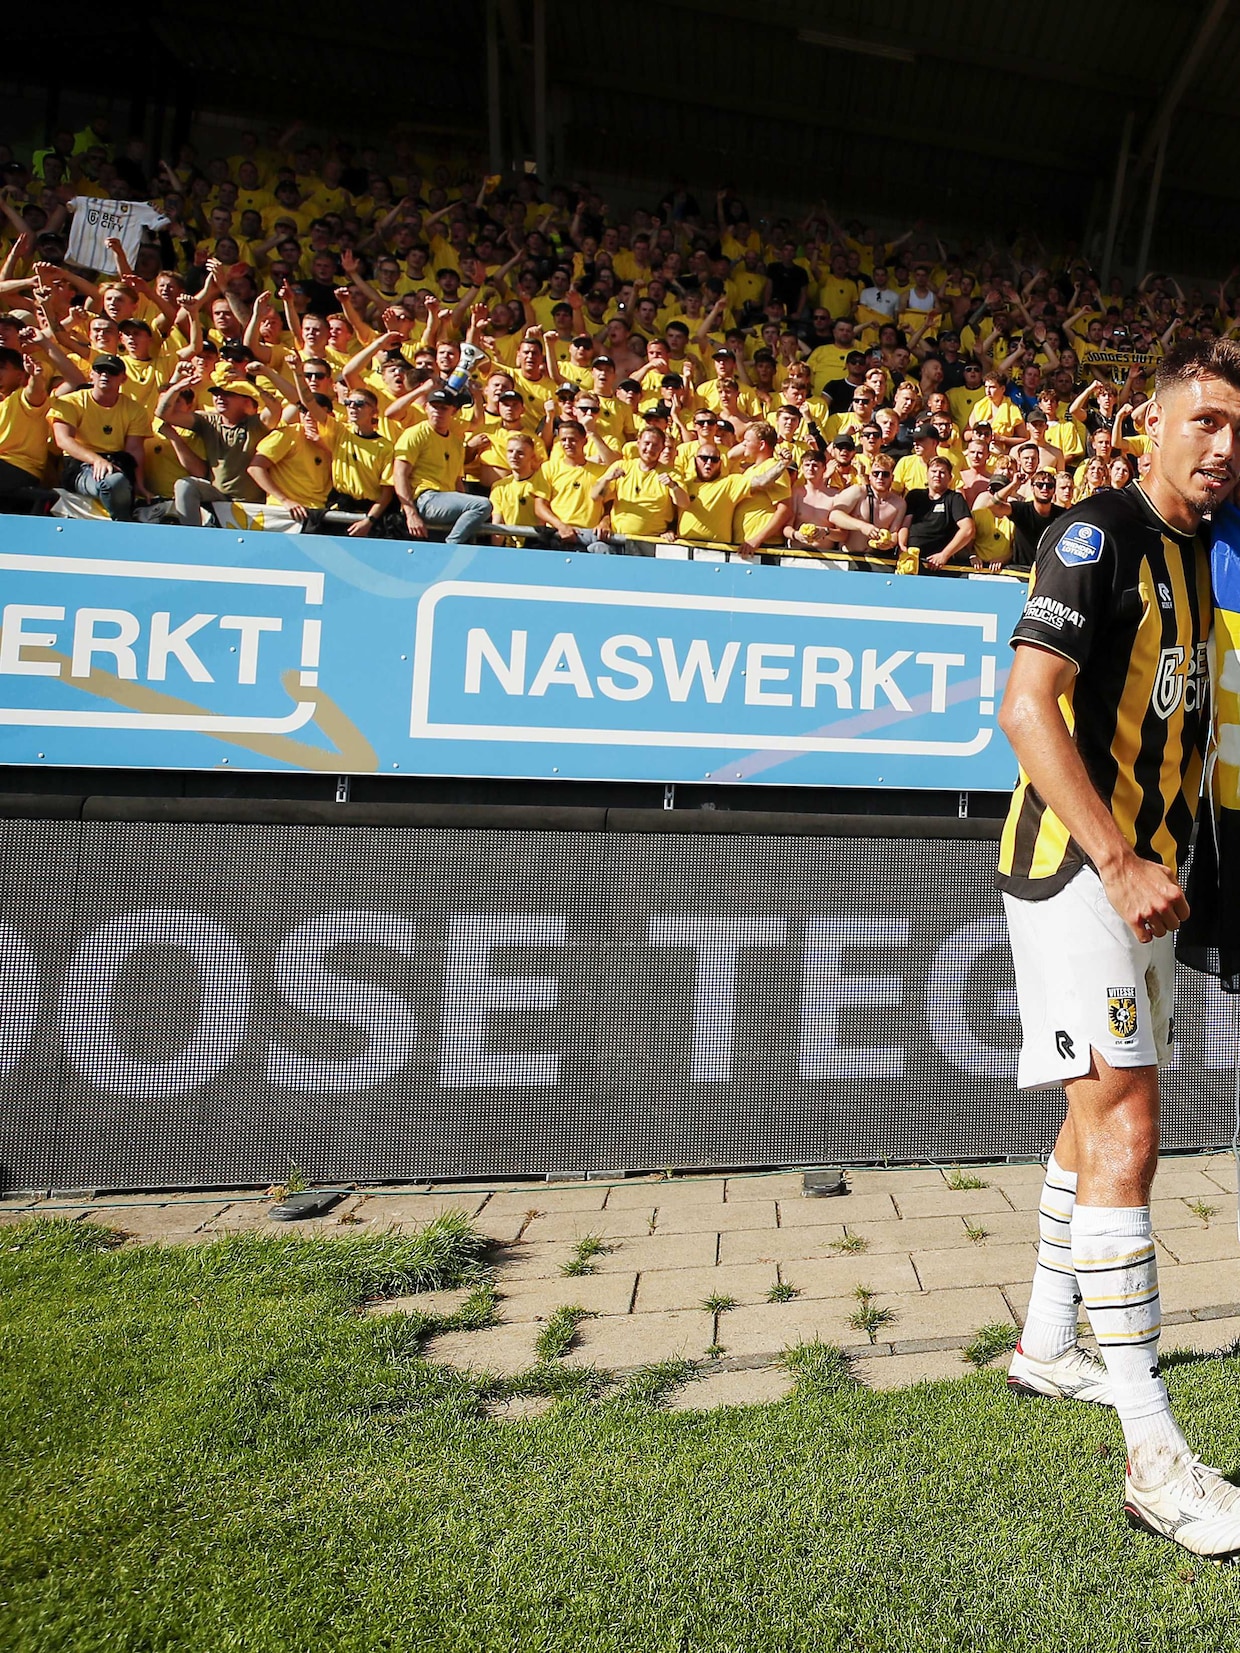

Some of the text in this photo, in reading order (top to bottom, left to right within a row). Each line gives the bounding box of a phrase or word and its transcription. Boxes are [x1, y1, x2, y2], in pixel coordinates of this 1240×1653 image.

[102, 213, 121, 223] BET
[101, 221, 124, 232] CITY
[463, 627, 997, 716] NASWERKT!
[1107, 987, 1136, 998] VITESSE
[0, 908, 567, 1098] OSE
